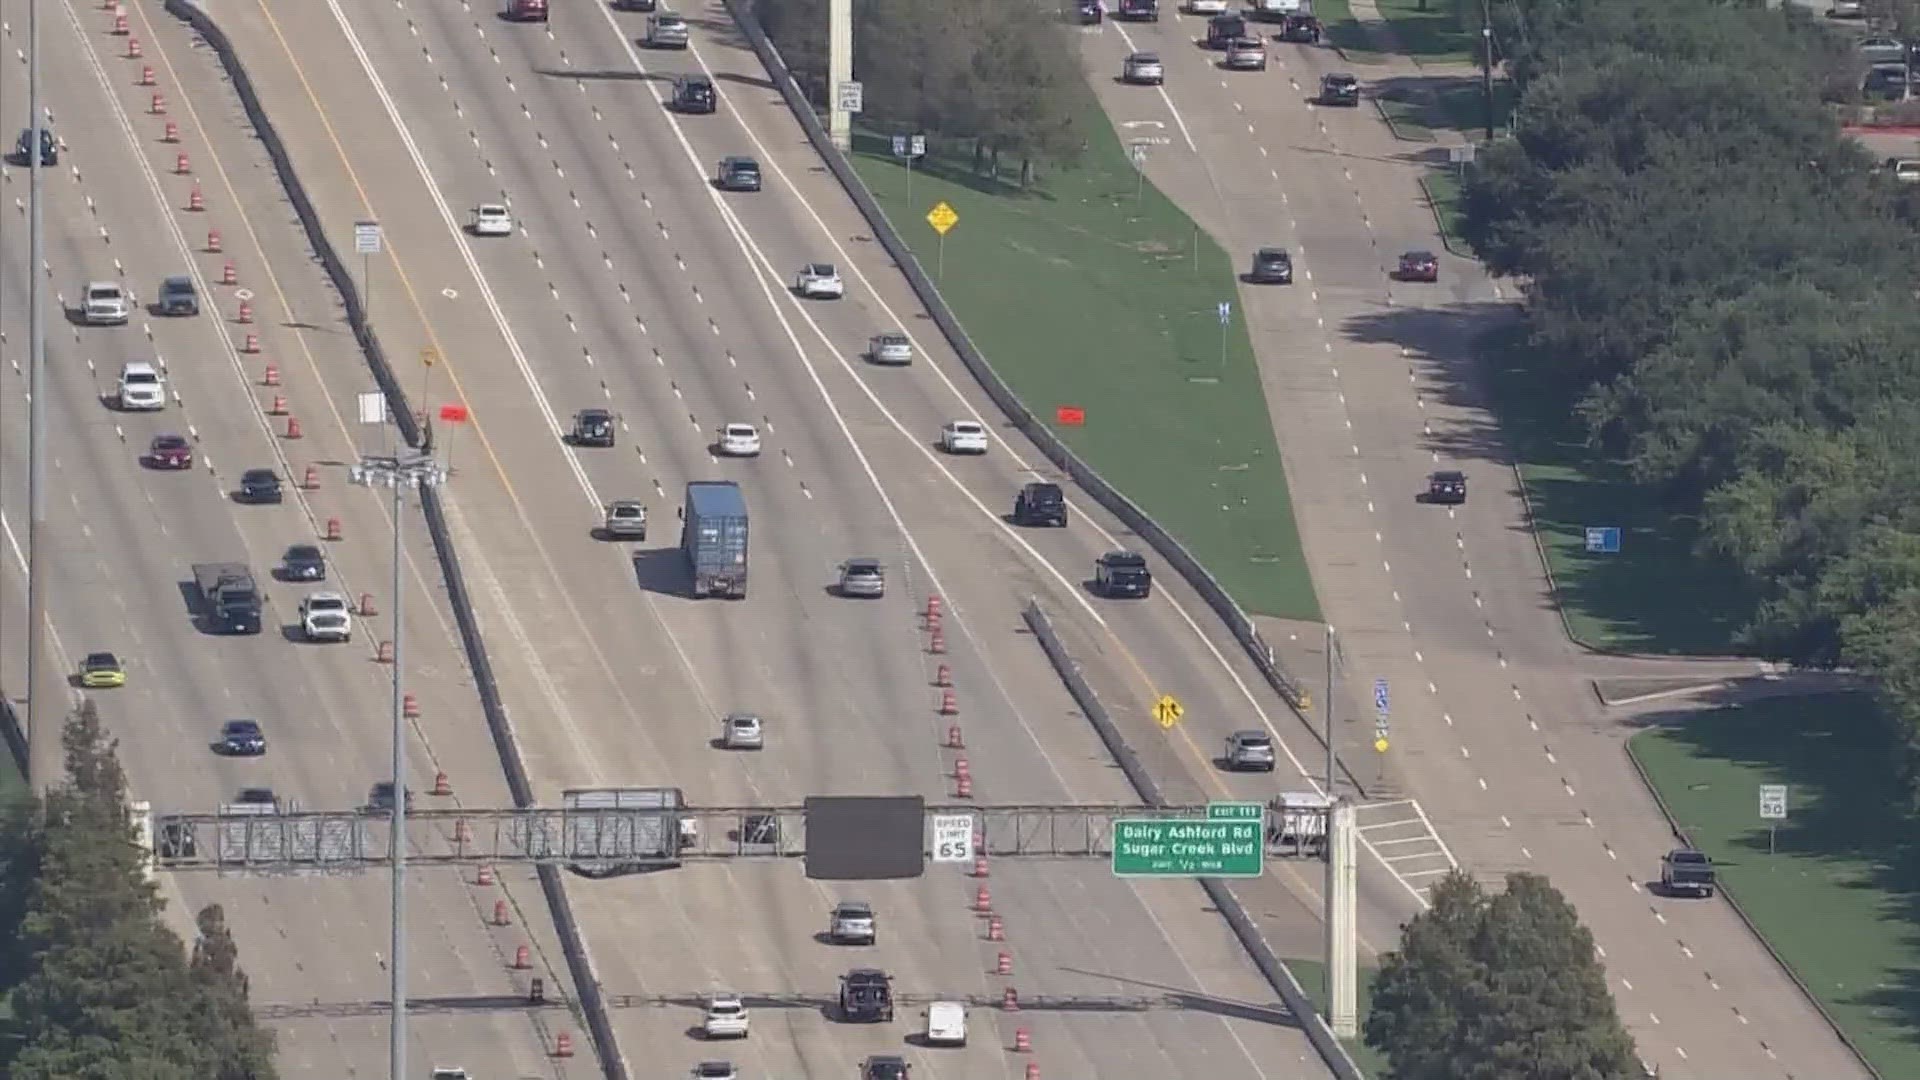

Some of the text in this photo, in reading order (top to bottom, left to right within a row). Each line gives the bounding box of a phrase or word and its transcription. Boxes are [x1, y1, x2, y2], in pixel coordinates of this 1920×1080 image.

[1123, 825, 1253, 841] Dairy Ashford Rd
[940, 842, 966, 857] 65
[1122, 843, 1253, 857] Sugar Creek Blvd
